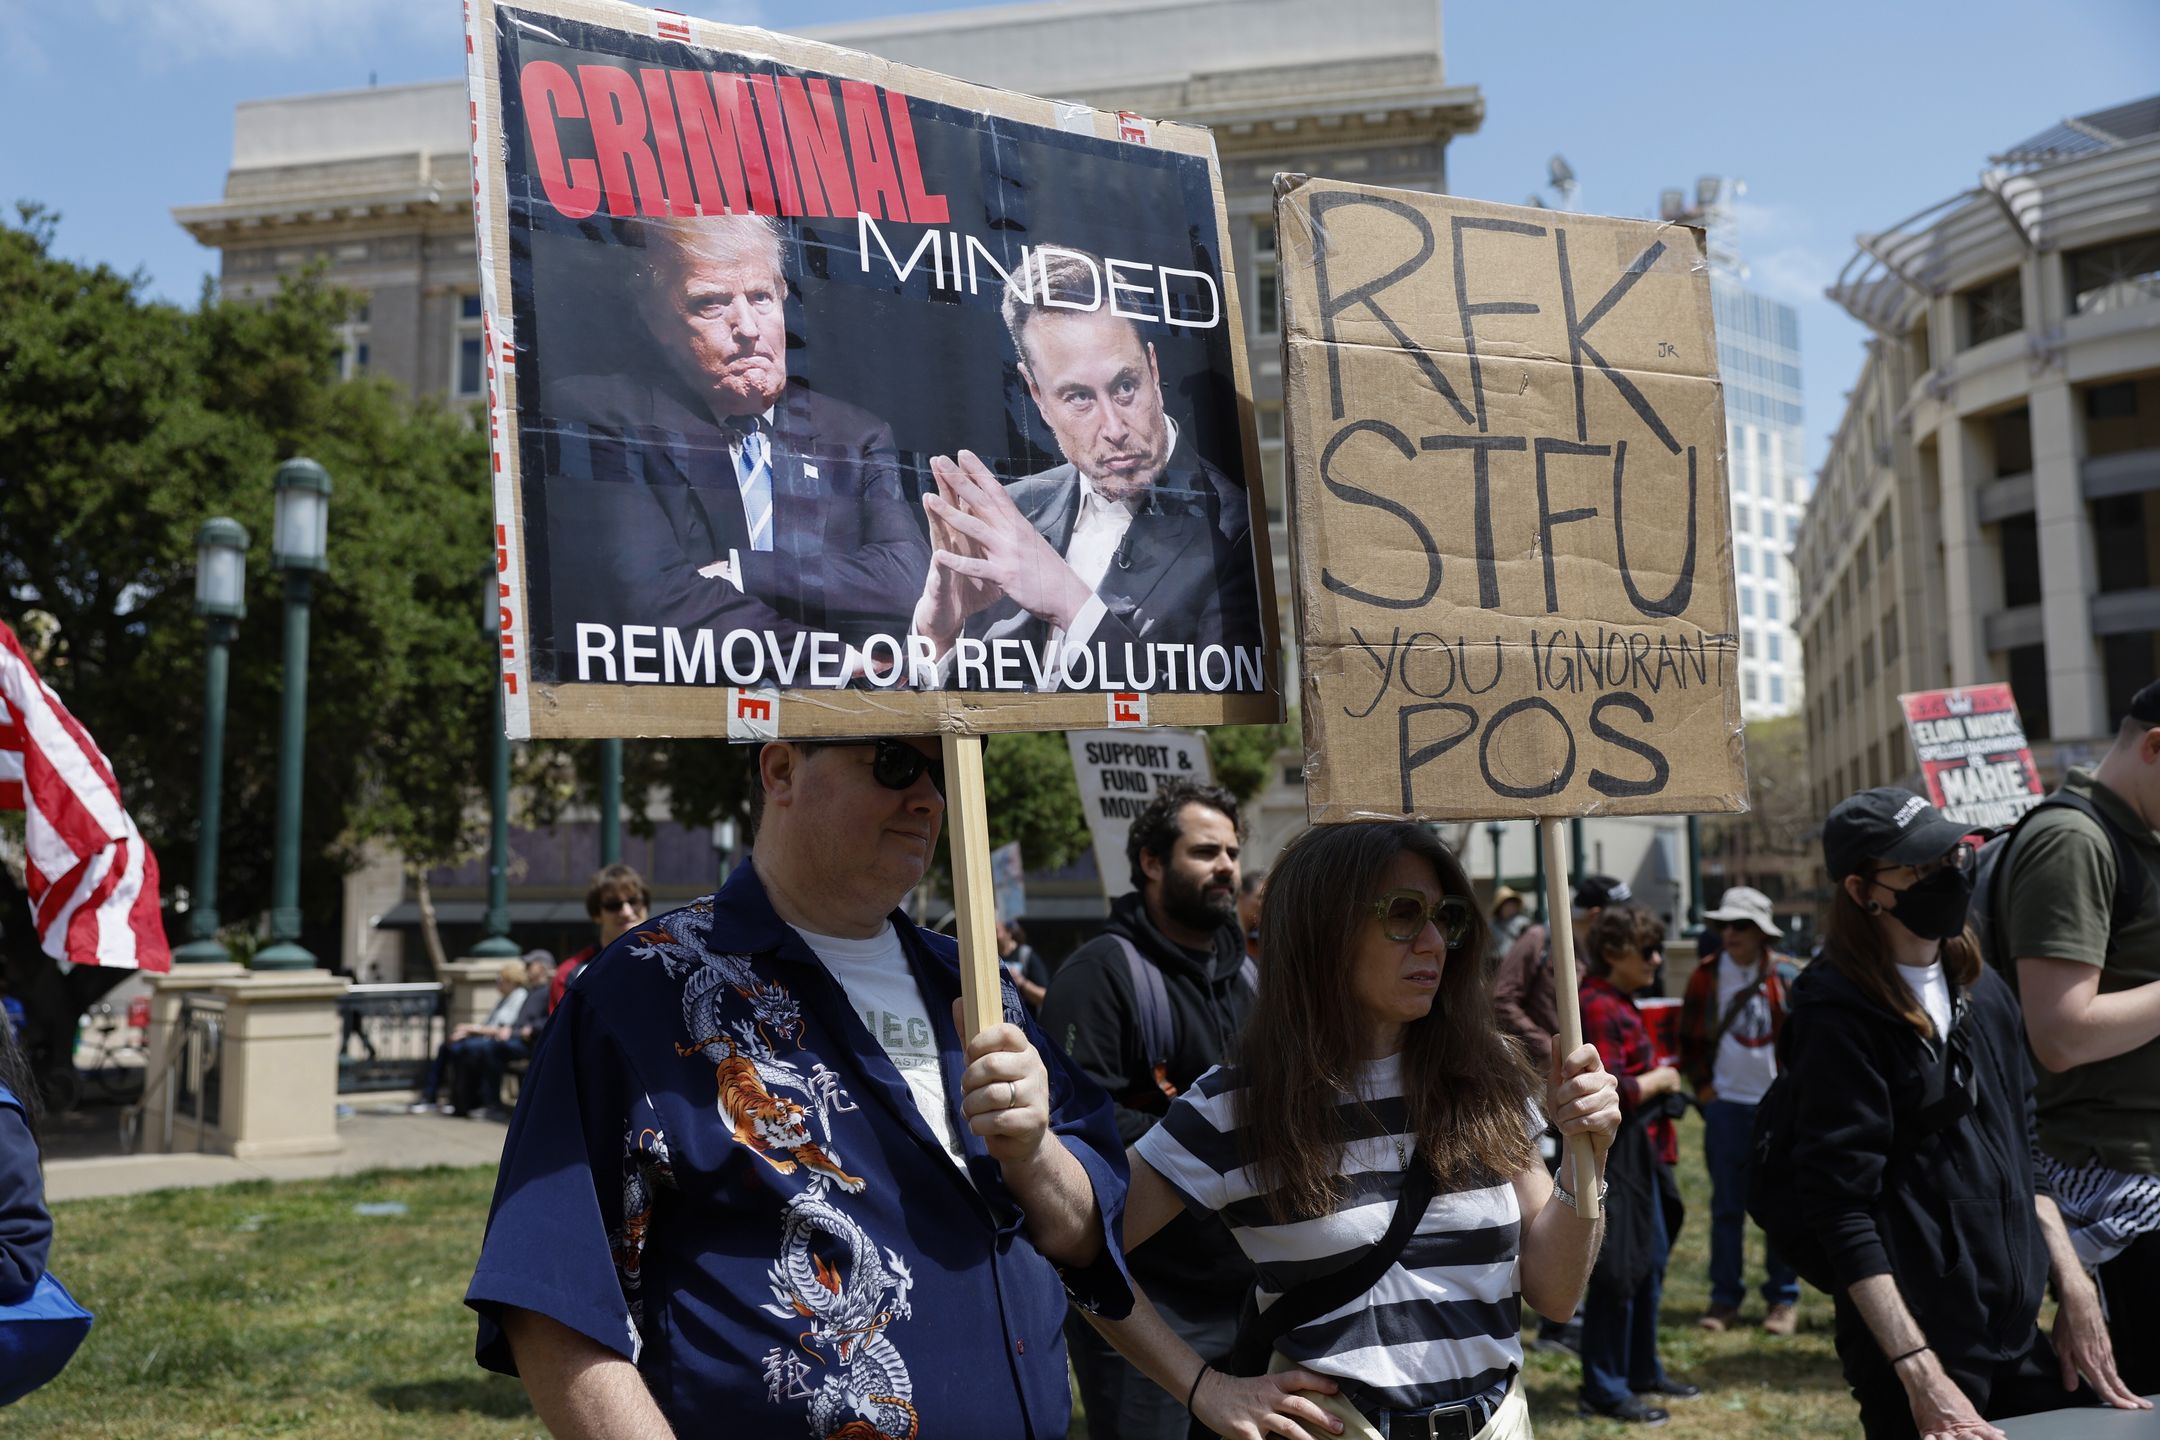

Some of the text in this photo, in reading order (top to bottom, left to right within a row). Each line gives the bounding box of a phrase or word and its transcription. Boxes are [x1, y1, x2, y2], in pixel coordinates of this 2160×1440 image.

[520, 60, 950, 224] CRIMINAL
[857, 211, 1220, 329] MINDED
[1309, 191, 1682, 455] RFK JR
[1320, 419, 1697, 618] STFU
[576, 623, 1265, 692] REMOVE OR REVOLUTION
[1344, 626, 1739, 718] YOU IGNORANT
[1086, 742, 1192, 770] SUPPORT &
[1101, 769, 1148, 793] FUND
[1398, 692, 1669, 813] POS
[1938, 761, 2031, 805] MARIE
